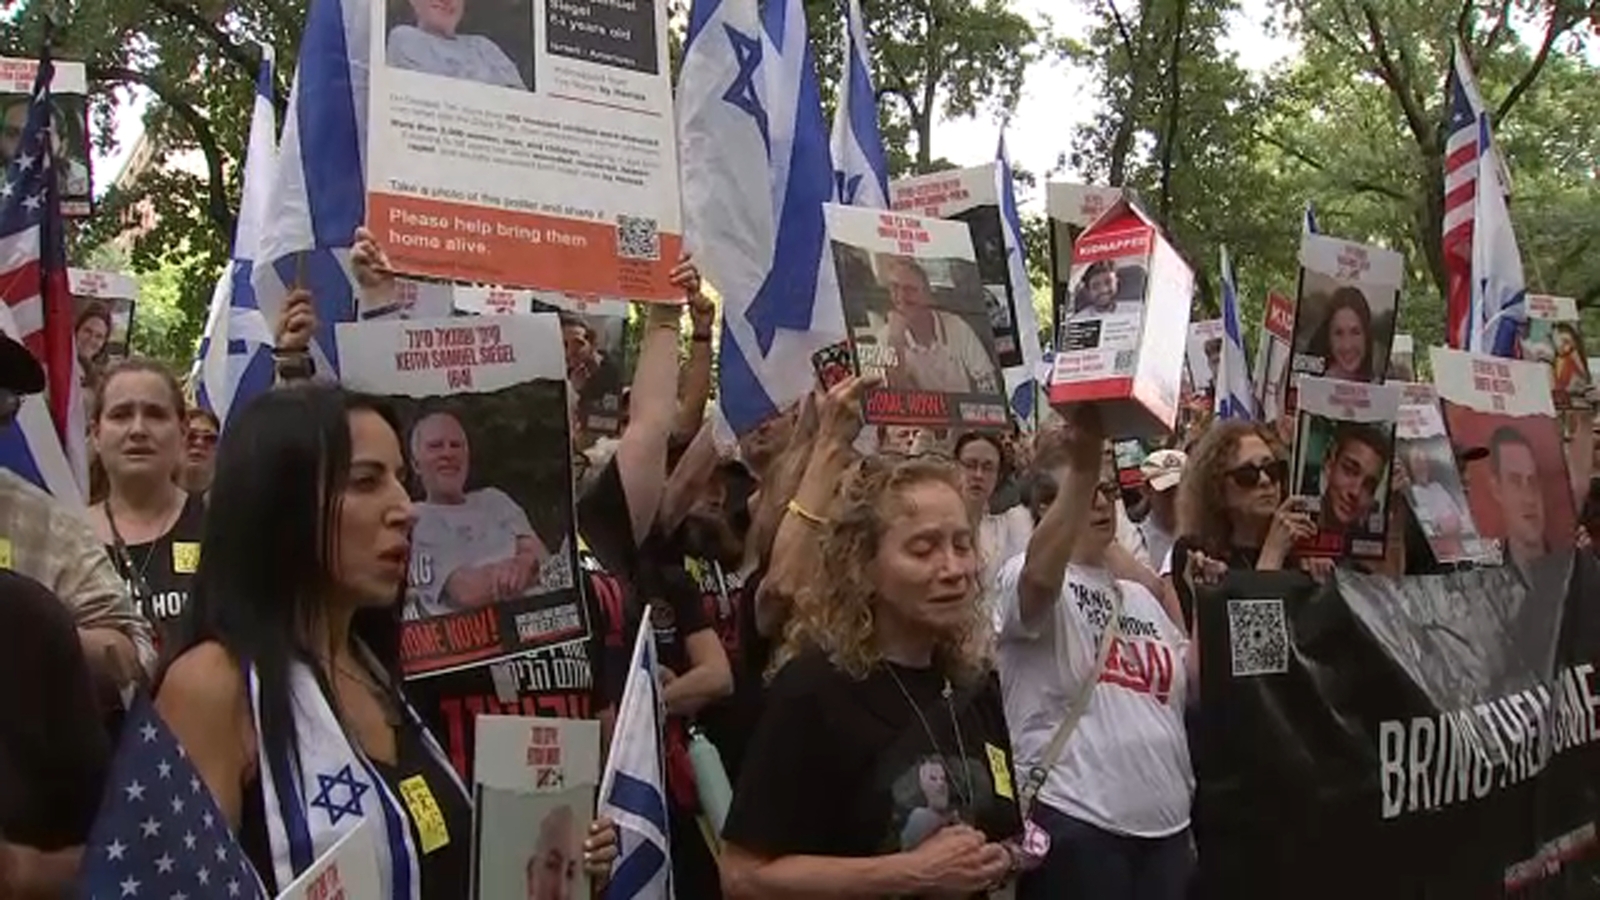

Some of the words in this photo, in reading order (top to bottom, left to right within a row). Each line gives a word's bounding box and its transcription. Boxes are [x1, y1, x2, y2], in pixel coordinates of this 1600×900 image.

[569, 18, 606, 33] years
[609, 27, 631, 41] old
[389, 180, 418, 193] Take
[420, 186, 429, 196] a
[431, 187, 465, 201] photo
[481, 194, 501, 205] this
[503, 197, 538, 210] poster
[541, 203, 562, 213] and
[564, 206, 595, 219] share
[388, 207, 449, 229] Please
[454, 216, 492, 237] help
[496, 221, 542, 244] bring
[546, 228, 588, 247] them
[388, 229, 441, 249] home
[445, 237, 492, 256] alive.
[1079, 238, 1148, 256] KIDNAPPED
[394, 351, 431, 371] KEITH
[431, 346, 479, 370] SAMUEL
[479, 343, 517, 365] SIEGEL
[444, 606, 499, 653] NOW!
